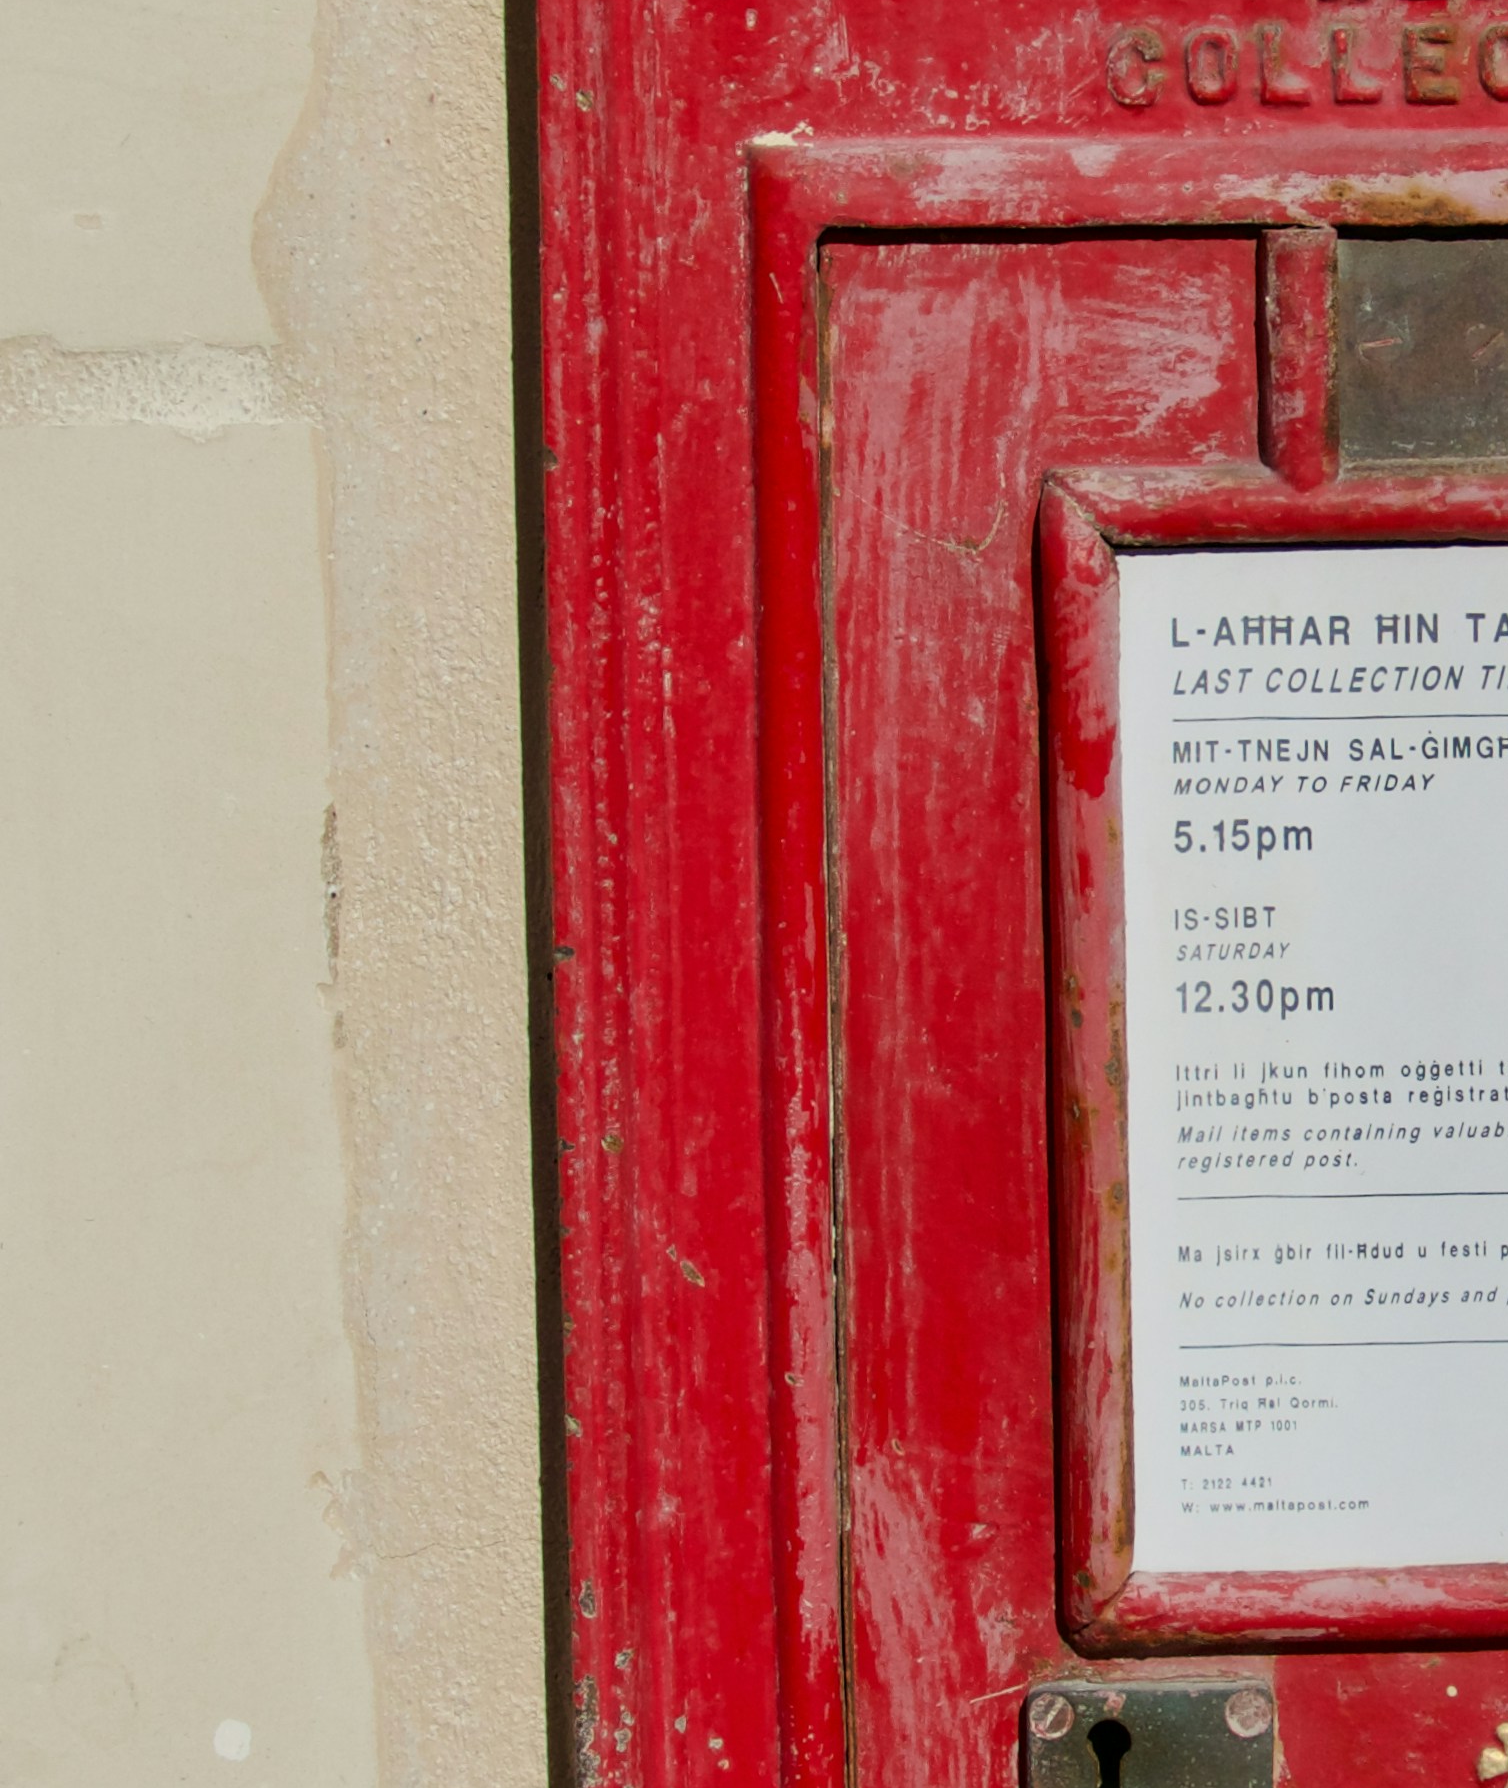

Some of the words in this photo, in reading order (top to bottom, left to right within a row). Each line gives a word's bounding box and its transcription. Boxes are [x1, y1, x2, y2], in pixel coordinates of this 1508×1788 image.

[1373, 612, 1439, 646] ĦIN
[1172, 667, 1254, 696] LAST
[1265, 664, 1465, 694] COLLECTION
[1172, 738, 1329, 765] MIT-TNEJN
[1173, 774, 1285, 796] MONDAY
[1297, 775, 1328, 794] TO
[1339, 773, 1436, 794] FRIDAY
[1173, 818, 1313, 862] 5.15pm
[1174, 905, 1277, 932] IS-SIBT
[1176, 941, 1291, 962] SATURDAY
[1175, 978, 1335, 1021] 12.30pm
[1233, 1062, 1246, 1080] li
[1260, 1061, 1308, 1085] jkun
[1323, 1061, 1385, 1080] fihom
[1400, 1058, 1483, 1082] oġġetti
[1176, 1087, 1293, 1112] jintbagħtu
[1307, 1087, 1393, 1110] b'posta
[1177, 1125, 1223, 1144] Mail
[1232, 1124, 1291, 1142] items
[1303, 1122, 1422, 1145] containing
[1177, 1150, 1295, 1174] registered
[1303, 1149, 1358, 1171] post.
[1178, 1245, 1203, 1263] Ma
[1215, 1244, 1260, 1267] jsirx
[1274, 1243, 1312, 1265] ġbir
[1325, 1241, 1404, 1260] fil-Ħdud
[1417, 1245, 1427, 1259] u
[1440, 1240, 1487, 1259] festi
[1179, 1291, 1205, 1309] No
[1214, 1289, 1320, 1309] collection
[1330, 1293, 1354, 1307] on
[1363, 1287, 1451, 1308] Sundays
[1460, 1286, 1499, 1304] and
[1179, 1374, 1256, 1388] MaltaPost
[1179, 1421, 1227, 1434] MARSA
[1235, 1419, 1262, 1432] MTP
[1270, 1419, 1297, 1432] 1001
[1180, 1443, 1235, 1457] MALTA
[1202, 1477, 1232, 1491] 2122
[1209, 1499, 1370, 1513] www.maltapost.com
